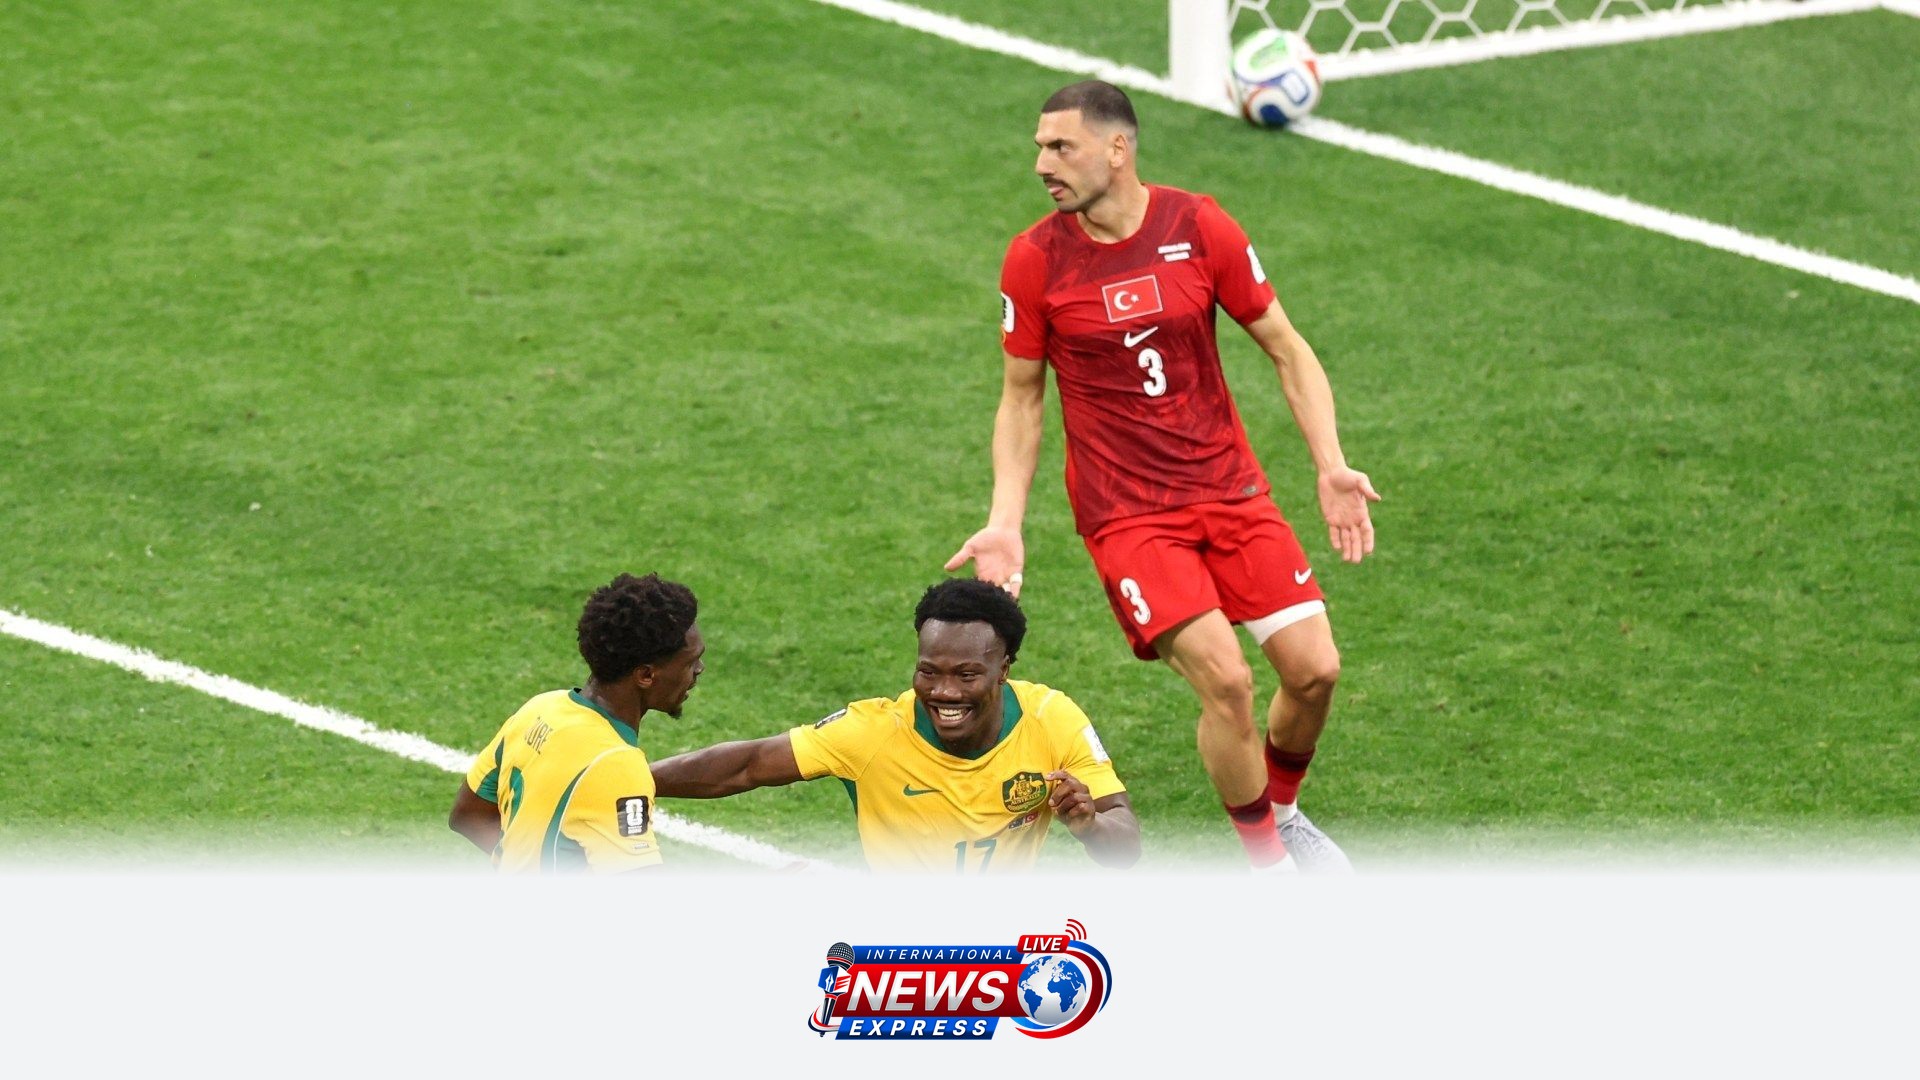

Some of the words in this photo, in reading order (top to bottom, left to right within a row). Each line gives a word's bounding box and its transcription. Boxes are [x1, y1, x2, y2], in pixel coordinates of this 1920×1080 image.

[1138, 348, 1168, 398] 3
[1119, 577, 1151, 625] 3
[954, 838, 998, 876] 17
